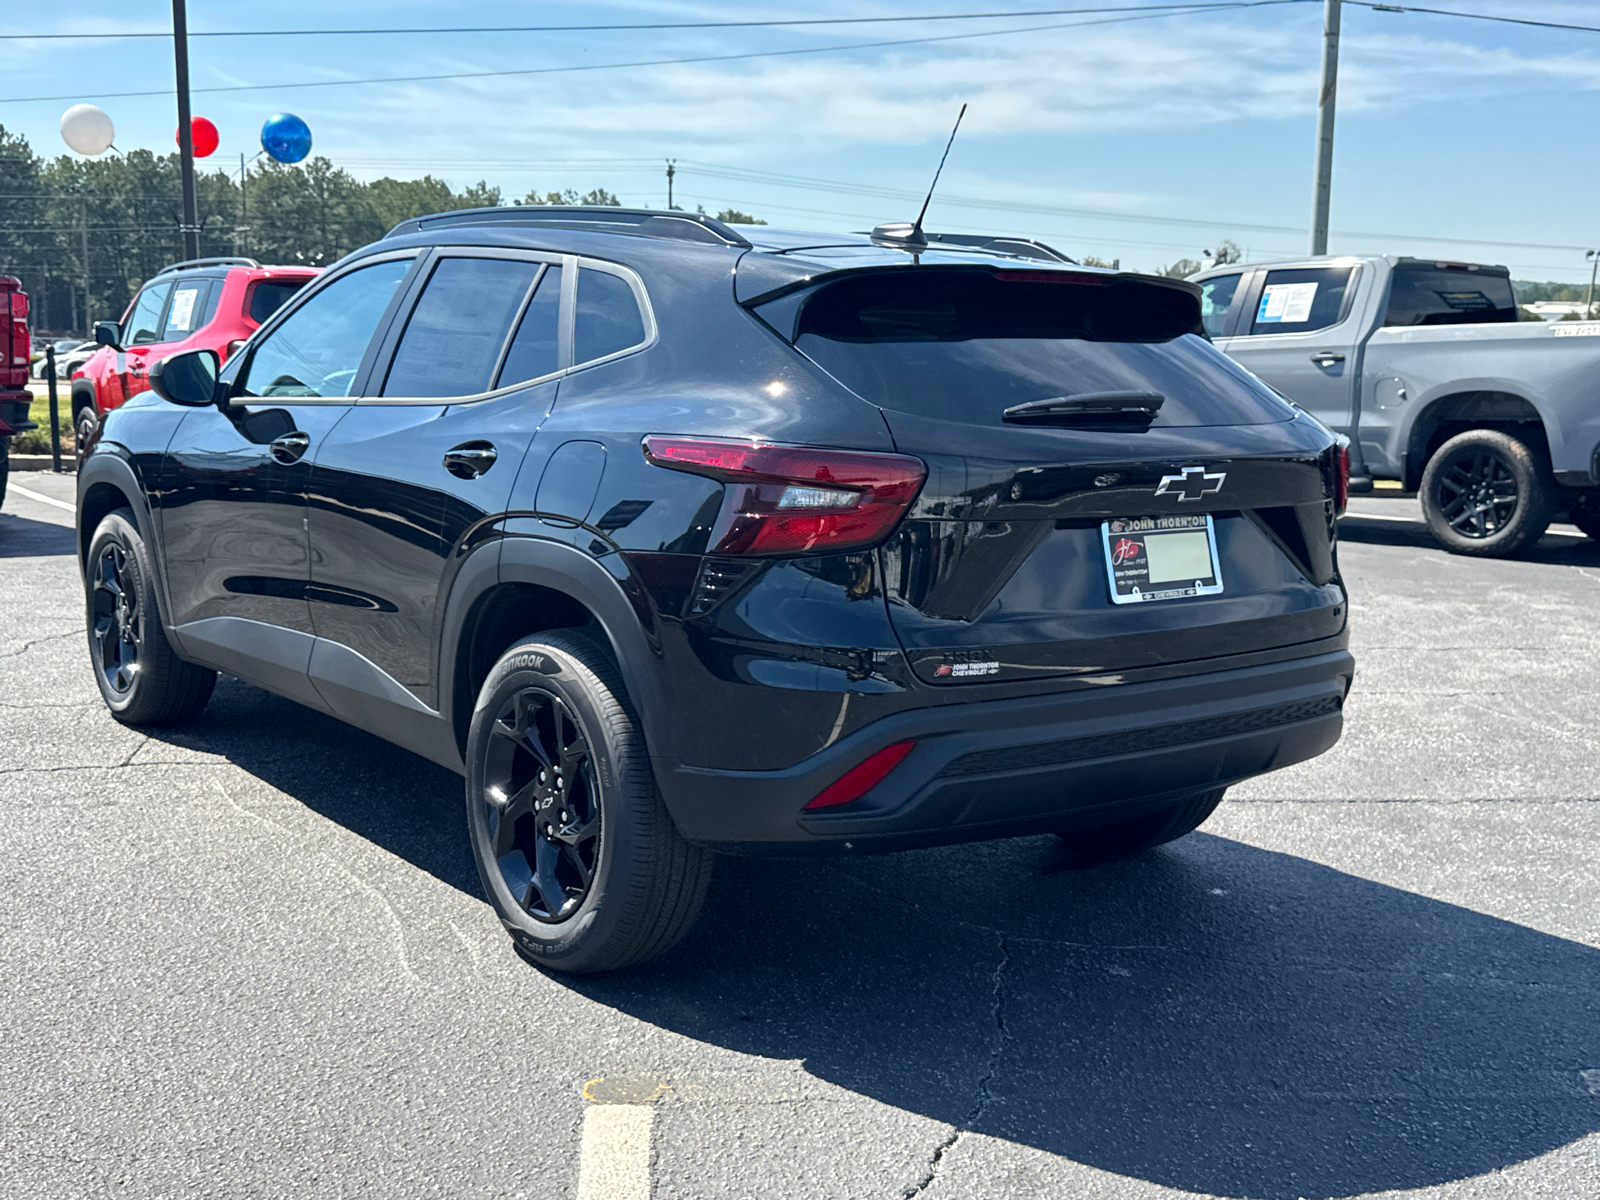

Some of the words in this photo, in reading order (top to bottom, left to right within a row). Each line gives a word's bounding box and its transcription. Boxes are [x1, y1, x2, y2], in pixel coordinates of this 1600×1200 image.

[1128, 519, 1155, 531] JOHN
[1156, 516, 1206, 529] THORNTON
[969, 661, 999, 669] THORNTON
